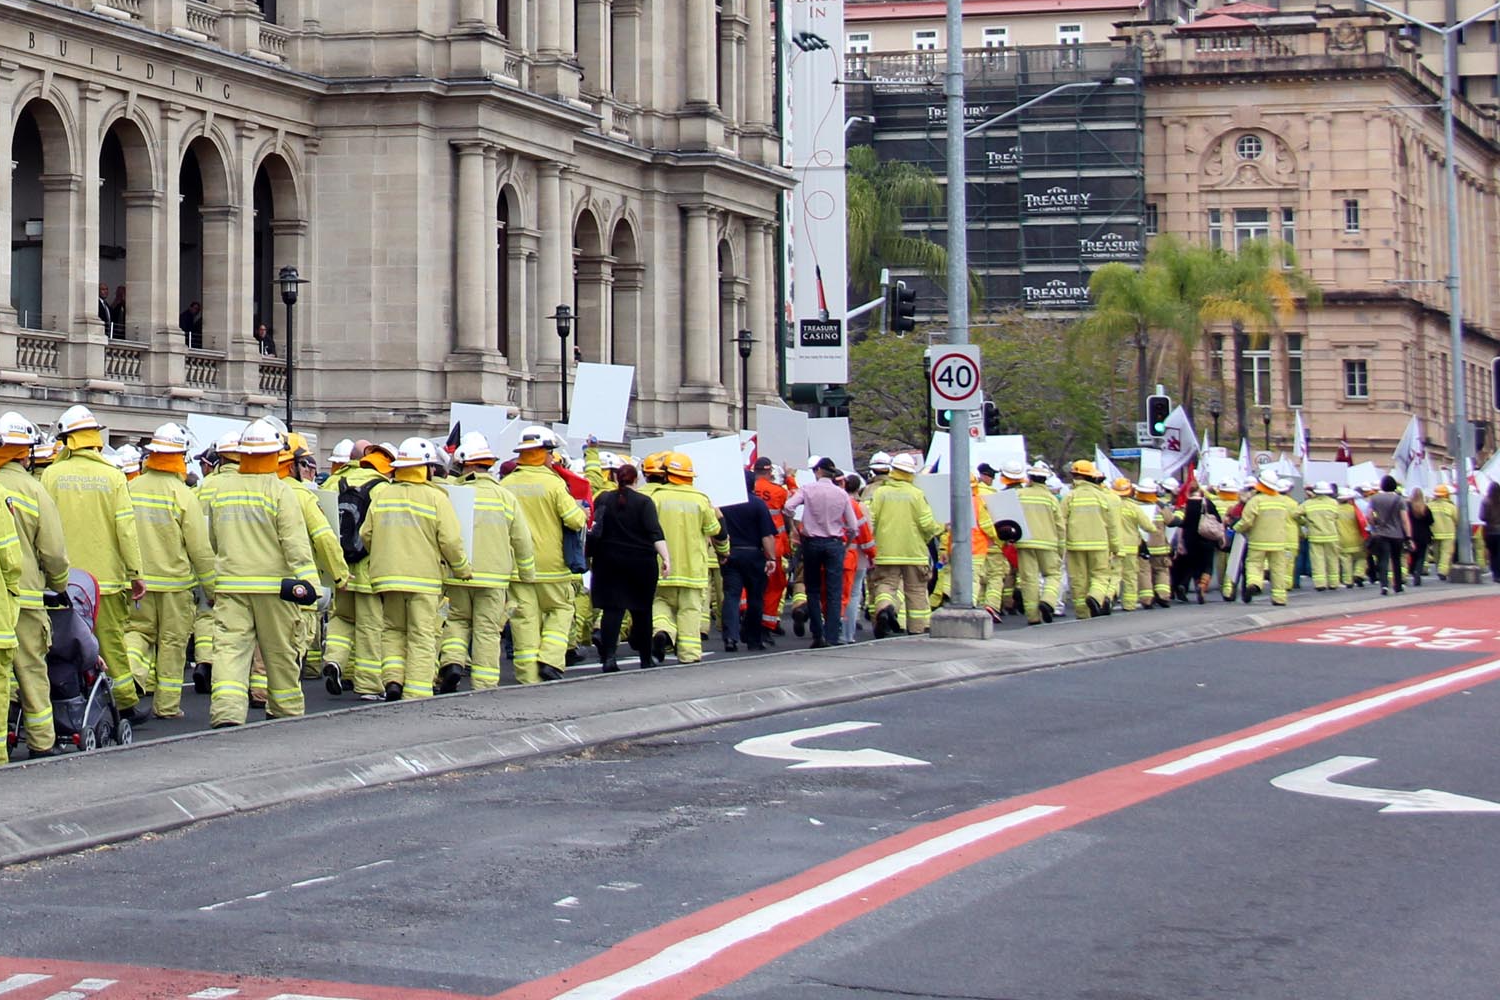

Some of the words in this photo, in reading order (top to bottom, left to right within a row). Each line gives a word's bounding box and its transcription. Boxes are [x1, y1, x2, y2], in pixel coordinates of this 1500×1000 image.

[809, 5, 827, 18] IN
[28, 31, 231, 99] BUILDING
[1024, 193, 1091, 207] TREASURY
[1023, 286, 1090, 300] TREASURY
[937, 365, 972, 388] 40
